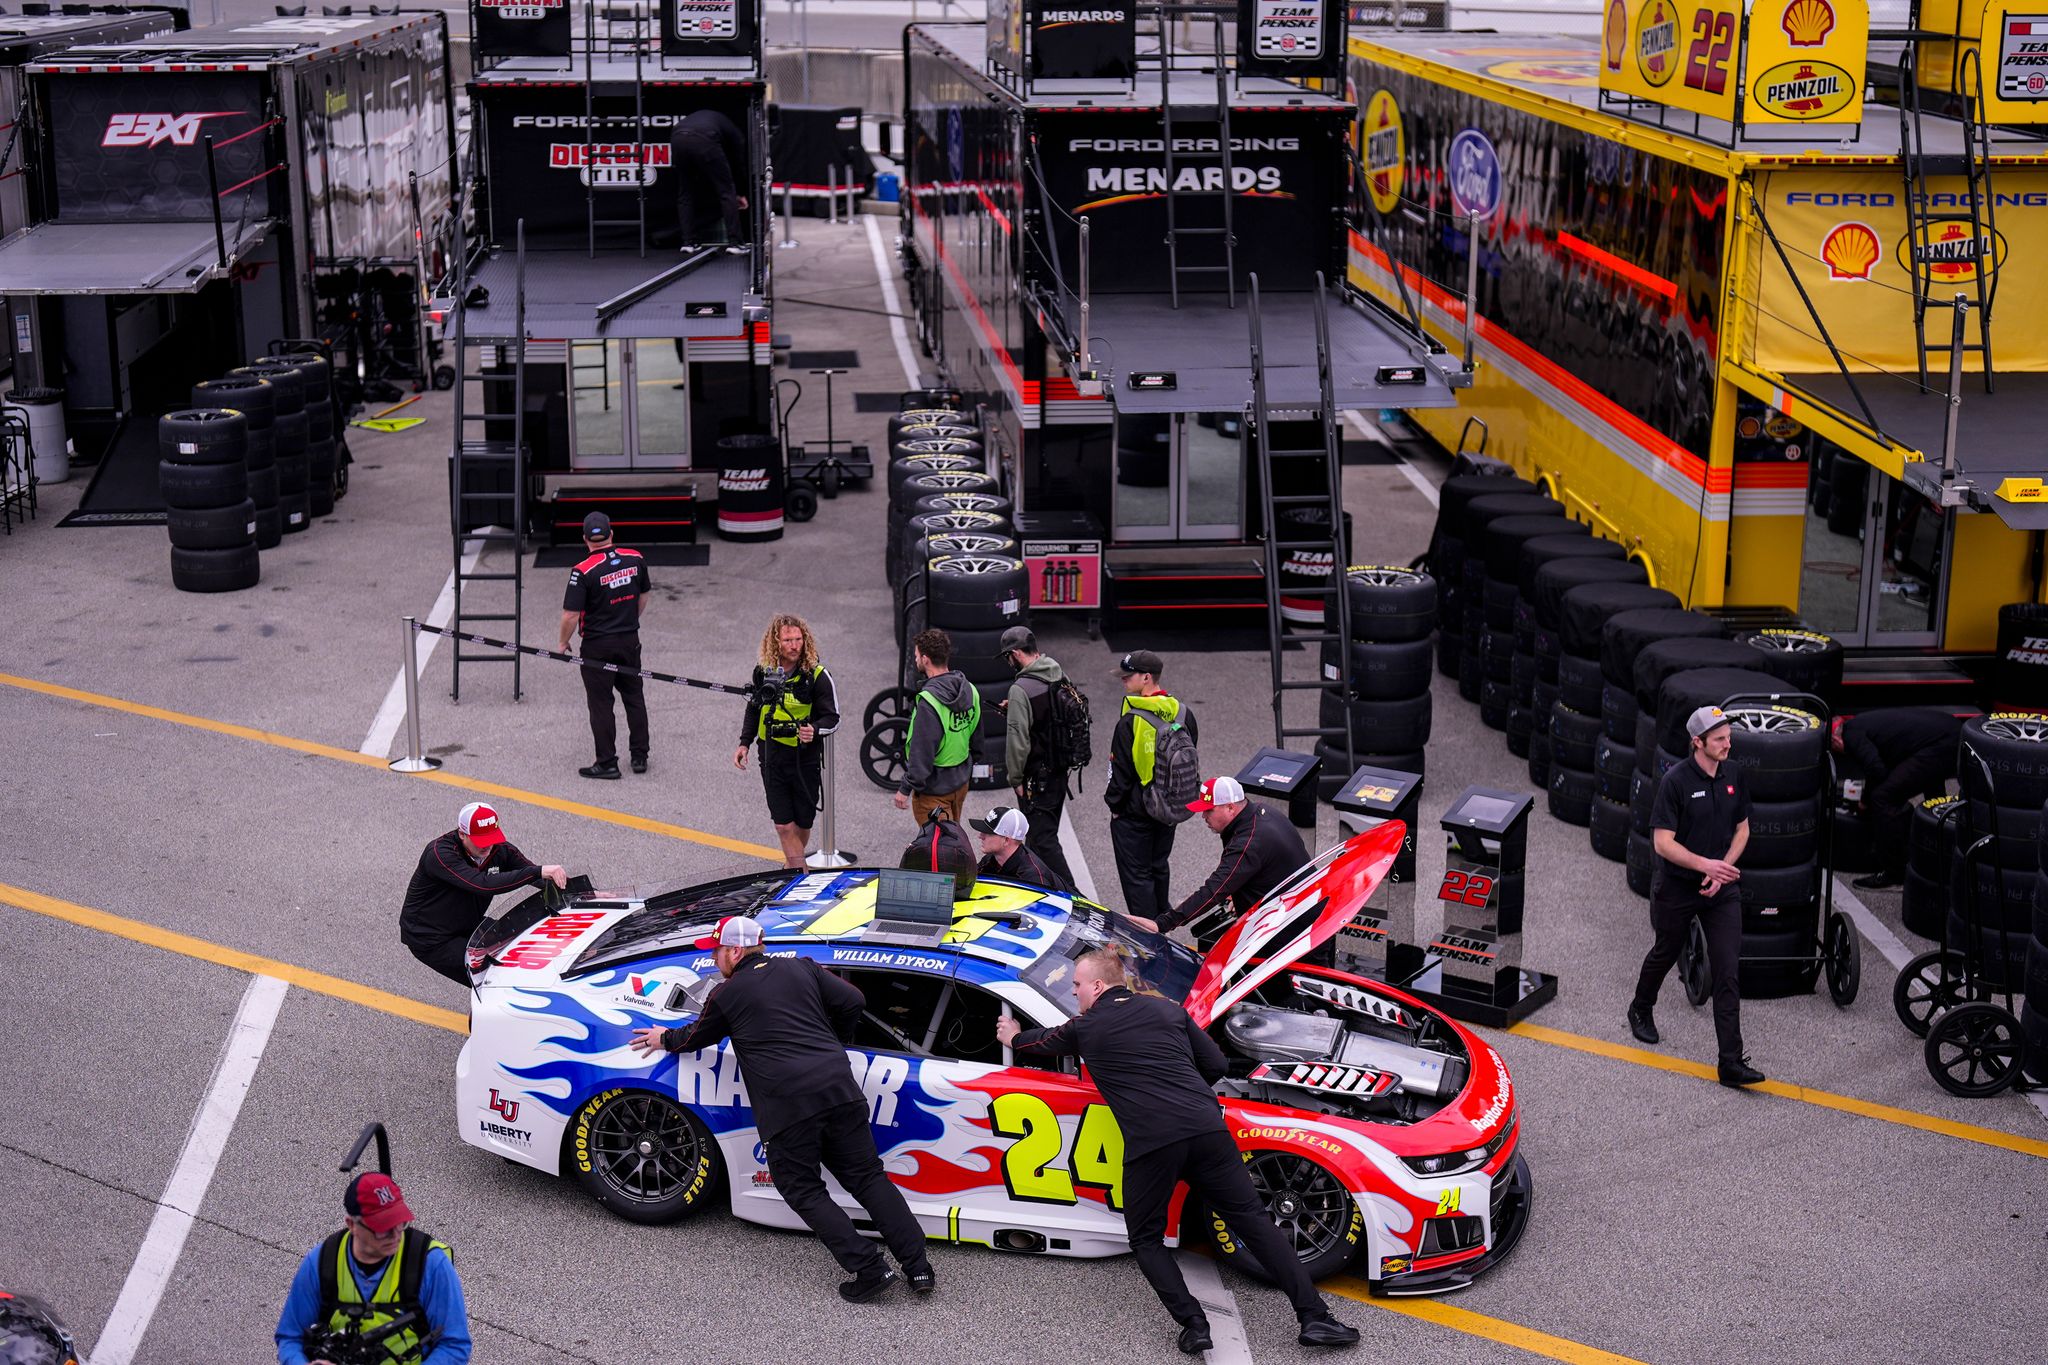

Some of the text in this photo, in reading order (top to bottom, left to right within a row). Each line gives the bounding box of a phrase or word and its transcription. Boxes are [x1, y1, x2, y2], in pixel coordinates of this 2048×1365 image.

[504, 8, 541, 17] TIRE
[680, 3, 732, 12] PENSKE
[1272, 7, 1314, 17] TEAM
[1042, 10, 1125, 22] MENARDS
[1259, 19, 1318, 28] PENSKE
[1684, 8, 1735, 96] 22
[2018, 42, 2048, 53] TEA
[2003, 55, 2048, 66] PENS
[1767, 76, 1840, 103] PENNZOIL
[2027, 77, 2044, 88] 60
[513, 115, 602, 128] FORD
[1069, 137, 1300, 152] FORD RACING
[550, 143, 672, 168] DISCOUN
[591, 169, 647, 182] TIRE
[1087, 166, 1282, 193] MENARDS
[1457, 139, 1493, 208] Ford
[1786, 192, 2048, 207] FORD RACNG
[724, 468, 767, 480] TEAM
[718, 478, 770, 491] PENSKE
[1292, 550, 1335, 563] TEAM
[600, 566, 638, 586] DISCOUNT
[1281, 562, 1335, 577] PENSK
[2022, 636, 2048, 649] TE
[2006, 649, 2048, 664] PEN
[1989, 712, 2048, 721] GOODY
[1438, 870, 1494, 909] 22
[1083, 909, 1105, 941] BYRON
[1350, 915, 1381, 929] AM
[499, 912, 607, 971] RAPTOR
[1336, 928, 1388, 943] NSKE
[1438, 933, 1490, 953] TEAM
[832, 949, 949, 971] WILLIAM BYRON
[1425, 944, 1497, 967] PENSKE
[623, 995, 656, 1009] Valvoline
[1470, 1047, 1512, 1133] RaptorCoatings.com
[480, 1120, 532, 1142] LIBERTY
[575, 1087, 624, 1173] GOODYEAR
[481, 1131, 532, 1149] UNIVERSITY
[1237, 1127, 1343, 1155] GOODYEAR
[986, 1091, 1125, 1214] 24
[683, 1155, 710, 1205] EAGLE
[1435, 1186, 1461, 1216] 24
[1381, 1259, 1411, 1273] SUNOCO
